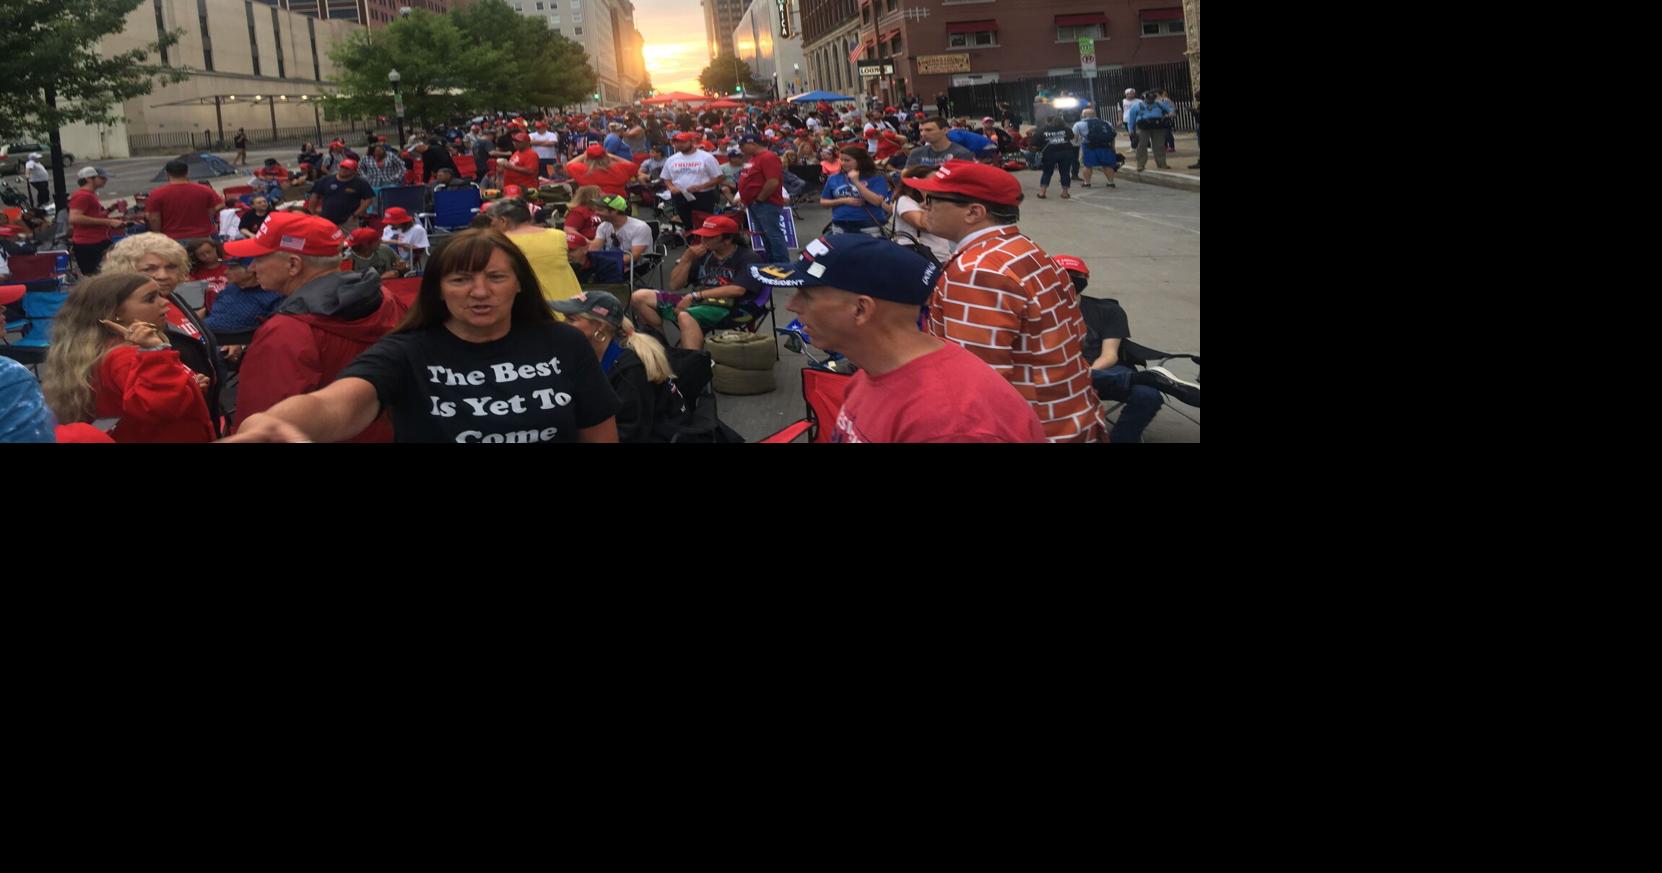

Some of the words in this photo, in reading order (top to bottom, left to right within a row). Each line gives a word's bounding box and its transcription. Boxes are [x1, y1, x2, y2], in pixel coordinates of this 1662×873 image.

[427, 365, 485, 385] The
[490, 357, 561, 382] Best
[430, 396, 456, 417] Is
[463, 395, 527, 416] Yet
[532, 388, 572, 409] To
[455, 427, 558, 443] Come
